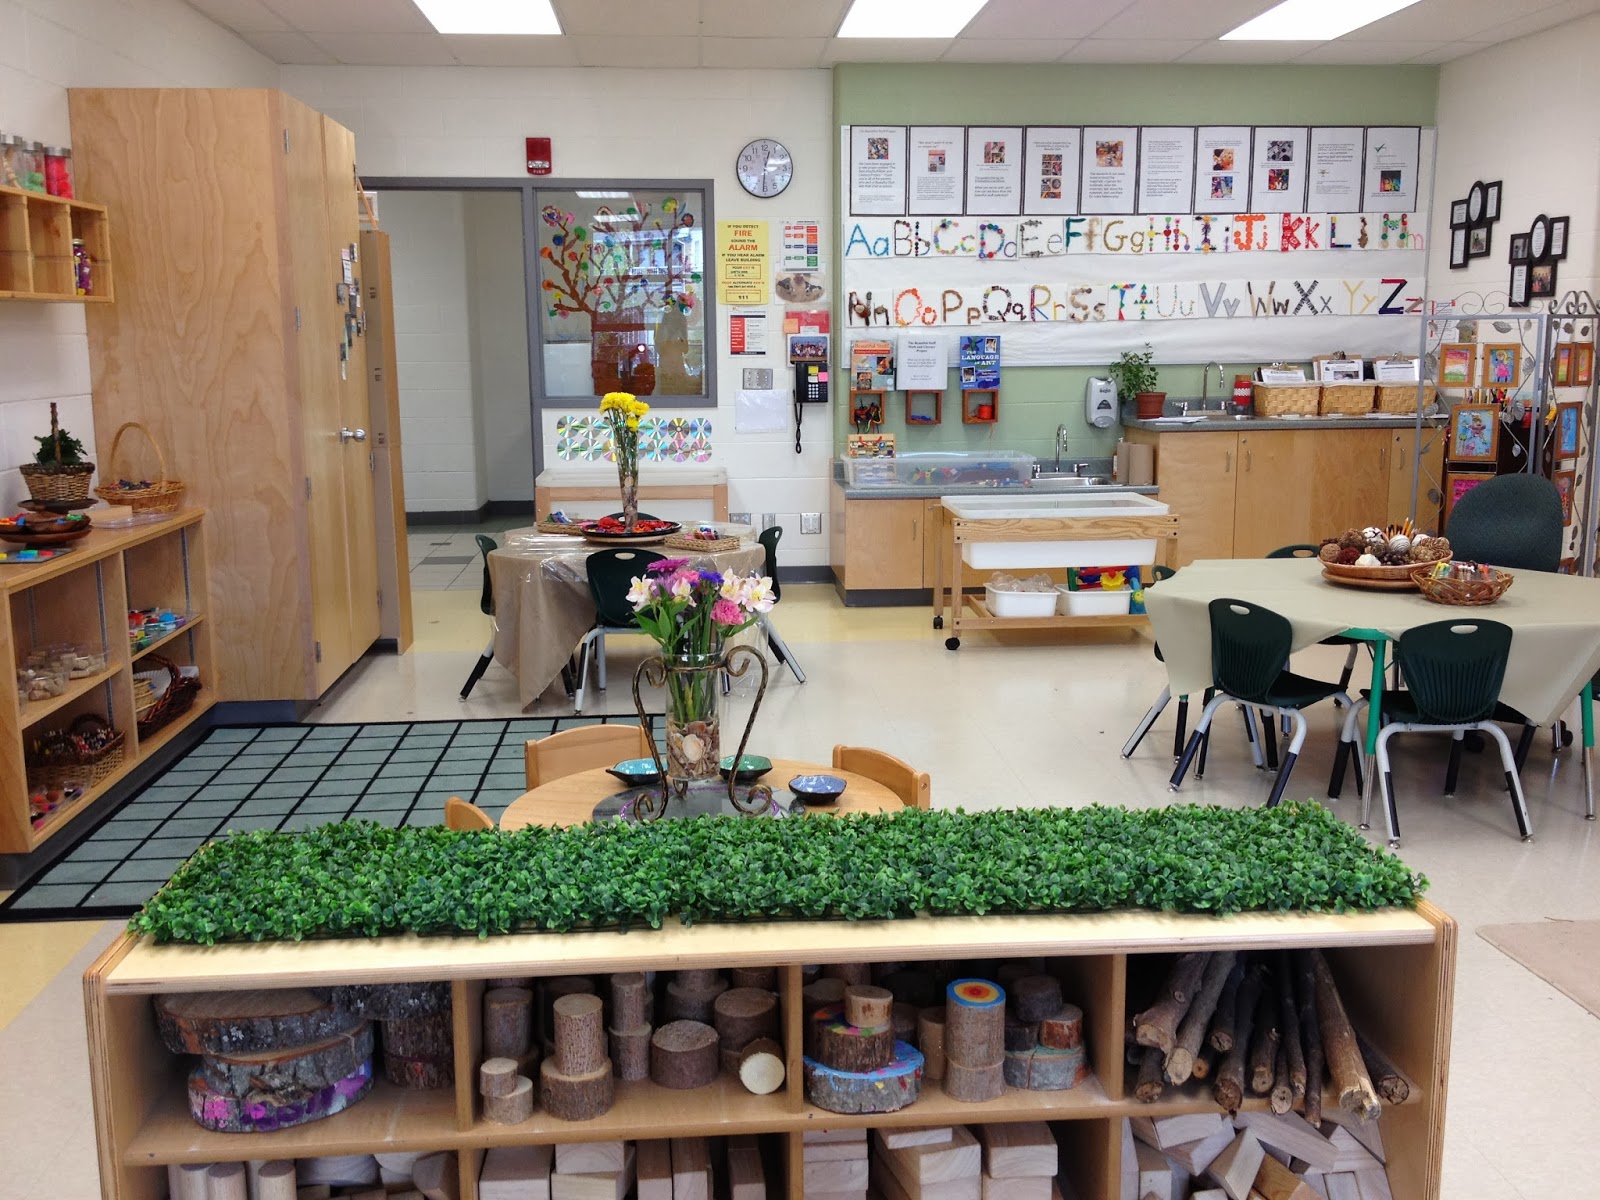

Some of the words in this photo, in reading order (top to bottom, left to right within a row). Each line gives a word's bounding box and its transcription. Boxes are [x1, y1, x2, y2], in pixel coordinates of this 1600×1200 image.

[845, 223, 889, 257] Aa
[894, 219, 931, 257] Bb
[933, 218, 976, 255] Cc
[1019, 219, 1063, 258] Ee
[1065, 216, 1101, 254] Ff
[1103, 219, 1145, 253] Gg
[1146, 216, 1191, 252] Hh
[1233, 214, 1267, 251] Jj
[1378, 213, 1424, 250] Mm
[941, 289, 981, 325] Pp
[982, 285, 1027, 322] Qq
[1030, 284, 1066, 322] Rr
[1069, 287, 1106, 323] Ss
[1155, 284, 1195, 318] Uu
[1199, 282, 1240, 319] Vv
[1292, 279, 1333, 316] Xx
[1342, 280, 1376, 315] Yy
[1378, 278, 1424, 315] Zz
